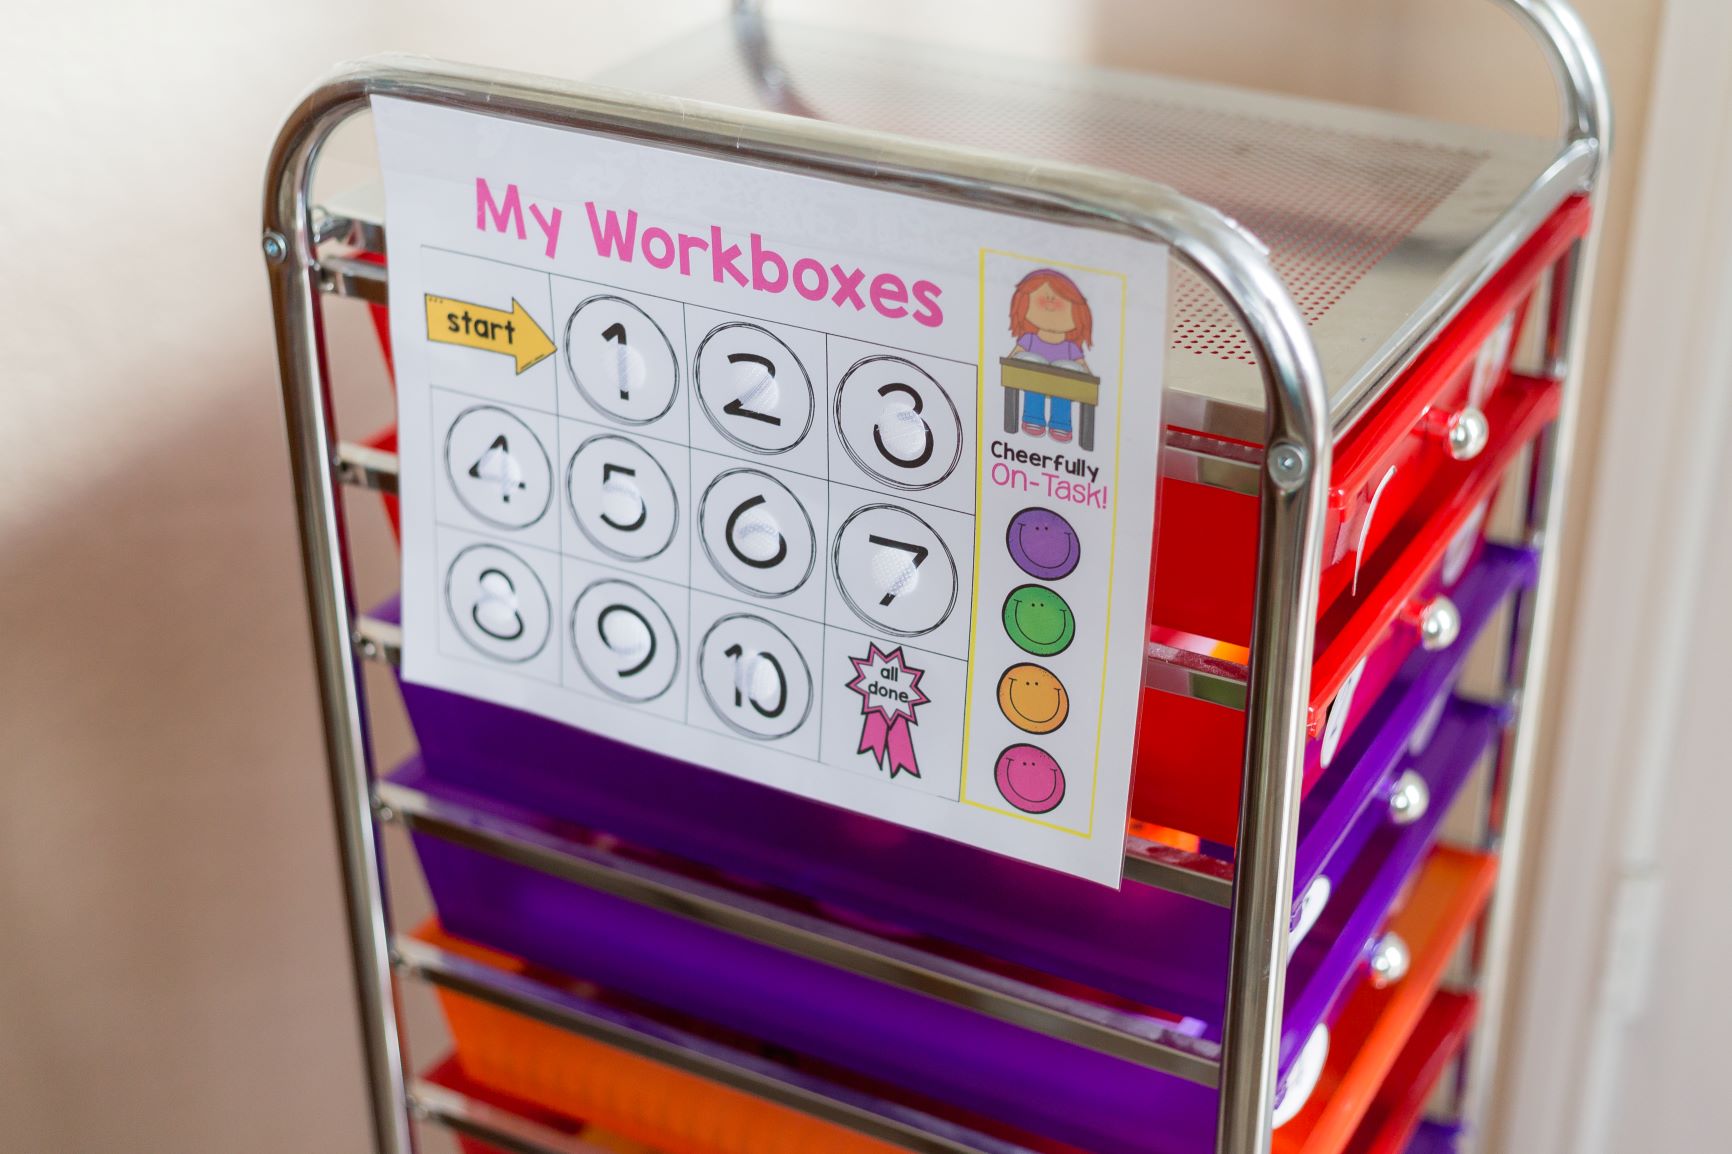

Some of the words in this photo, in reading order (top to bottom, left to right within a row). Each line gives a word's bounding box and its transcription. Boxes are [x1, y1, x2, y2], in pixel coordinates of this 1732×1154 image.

[475, 177, 562, 259] My
[584, 201, 944, 328] Workboxes
[447, 310, 515, 346] start
[601, 322, 629, 401] 1
[723, 352, 782, 427] 2
[872, 382, 935, 469] 3
[468, 434, 526, 504] 4
[600, 463, 647, 532] 5
[990, 440, 1099, 483] Cheerfully
[991, 462, 1108, 509] On-Task!
[725, 494, 788, 569] 6
[472, 568, 524, 641] 8
[868, 534, 929, 607] 7
[597, 604, 657, 678] 9
[880, 664, 899, 682] all
[724, 643, 788, 719] 10
[867, 680, 909, 704] done
